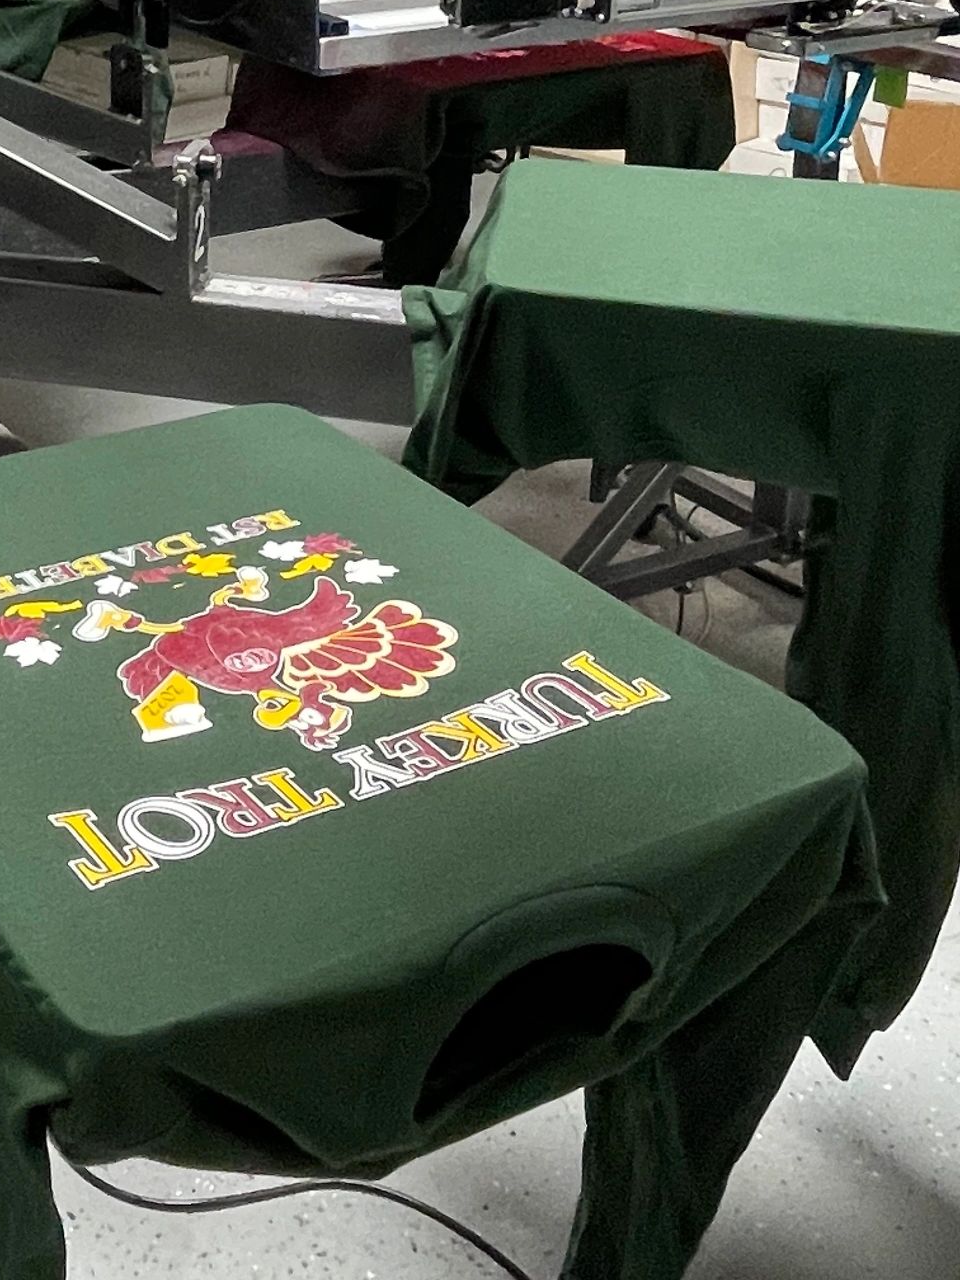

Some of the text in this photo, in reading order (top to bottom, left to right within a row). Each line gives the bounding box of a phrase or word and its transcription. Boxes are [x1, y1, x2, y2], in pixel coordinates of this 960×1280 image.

[141, 684, 184, 718] 2022
[48, 651, 671, 890] TURKEY TROT
